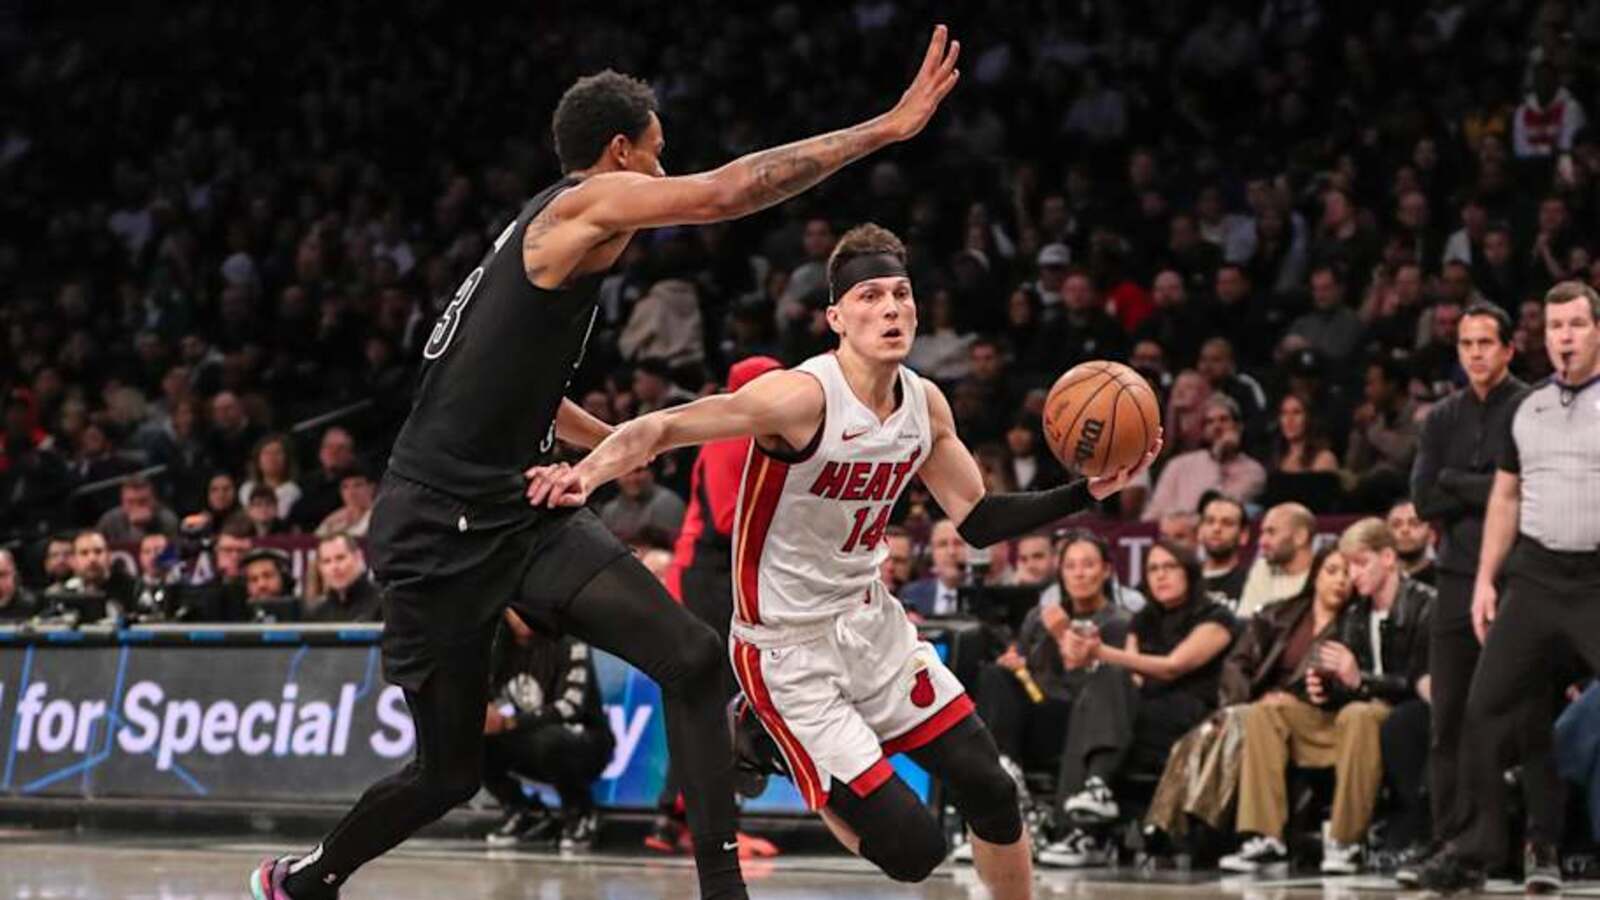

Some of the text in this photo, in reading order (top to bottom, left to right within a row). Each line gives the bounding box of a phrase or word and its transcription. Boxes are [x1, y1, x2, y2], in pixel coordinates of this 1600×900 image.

[809, 446, 921, 501] HEAT
[841, 504, 890, 553] 14
[16, 681, 106, 752] for
[117, 681, 358, 770] Special
